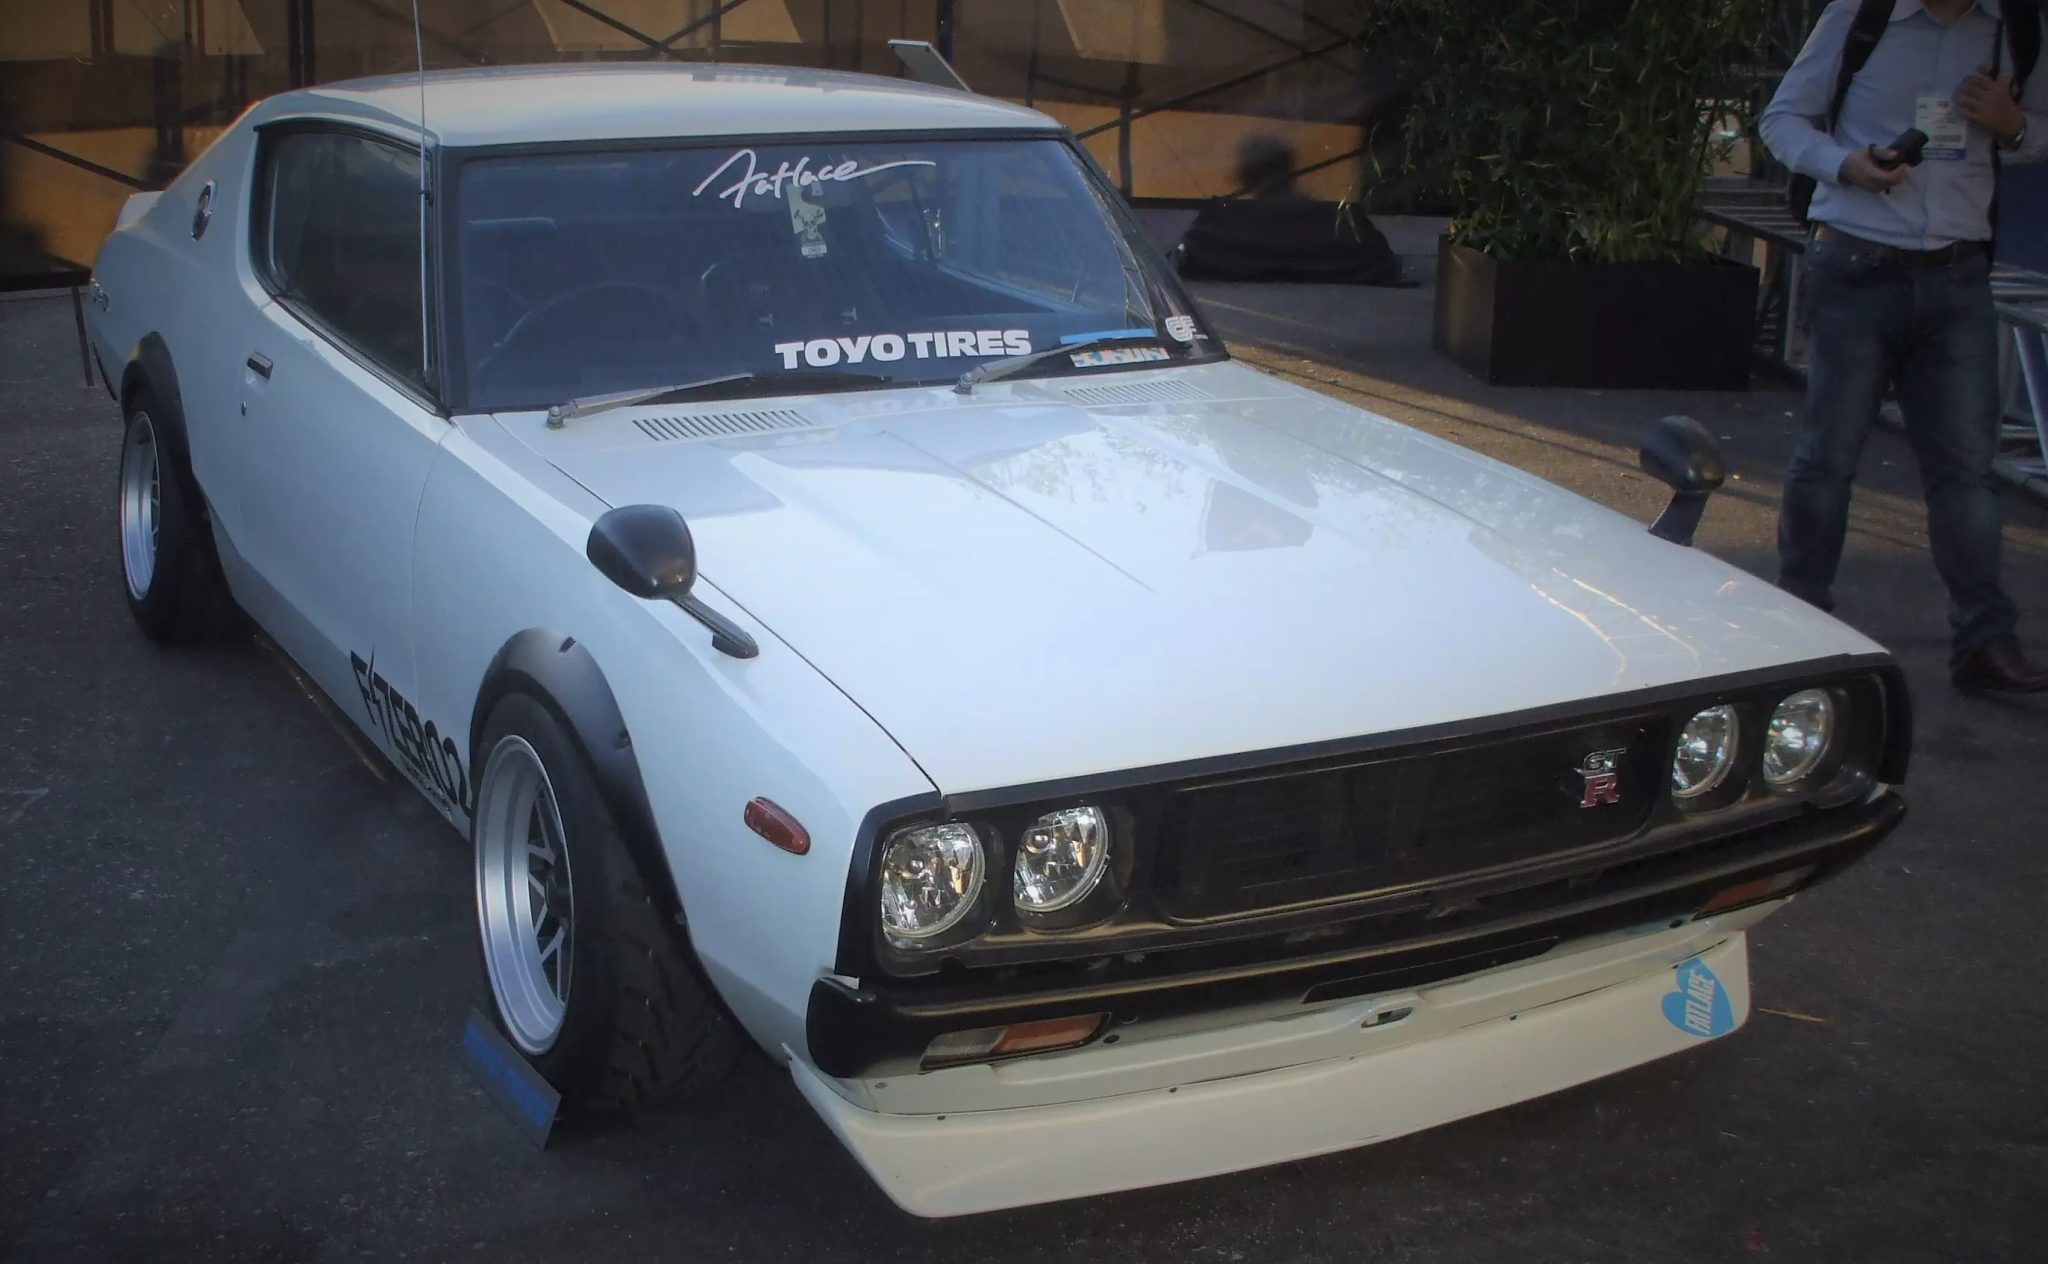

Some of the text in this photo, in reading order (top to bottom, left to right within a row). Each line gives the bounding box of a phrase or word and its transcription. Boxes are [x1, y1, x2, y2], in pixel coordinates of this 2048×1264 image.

[775, 334, 905, 370] TOYO
[907, 330, 1032, 358] TIRES
[1582, 747, 1626, 774] GT
[1580, 773, 1619, 808] R
[1685, 968, 1716, 1036] FATLACE
